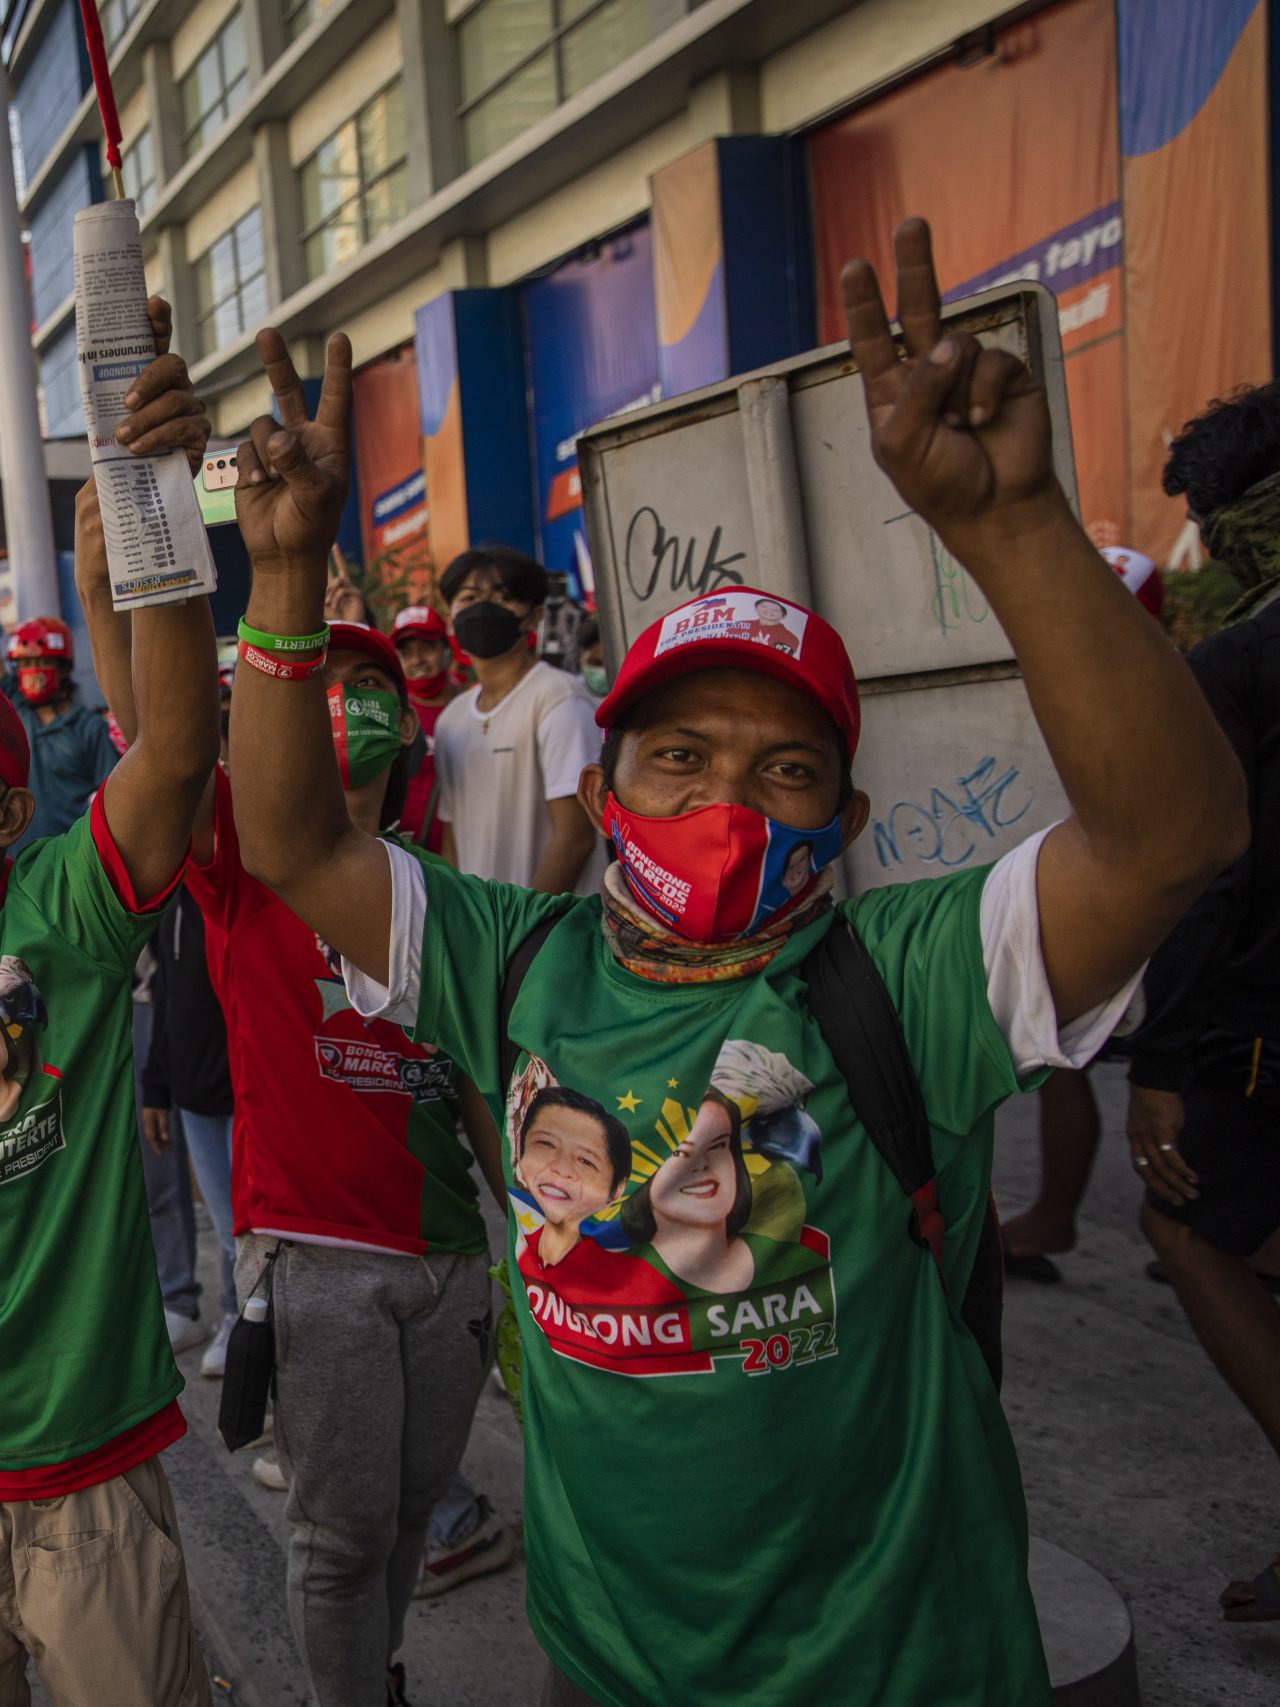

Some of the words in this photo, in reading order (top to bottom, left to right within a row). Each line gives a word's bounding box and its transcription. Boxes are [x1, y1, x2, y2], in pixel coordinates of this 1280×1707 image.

[99, 344, 156, 360] rontrunners
[98, 365, 137, 377] ROUNDUP
[121, 575, 162, 591] RESULTS
[674, 607, 736, 635] BBM
[274, 636, 323, 650] DUTERTE
[246, 650, 277, 671] MARCOS
[625, 847, 690, 906] MARCOS
[626, 840, 693, 894] BONGBONG
[659, 893, 686, 915] 2022
[4, 1134, 61, 1179] PRESIDENT
[706, 1284, 823, 1338] SARA
[739, 1321, 838, 1377] 2022
